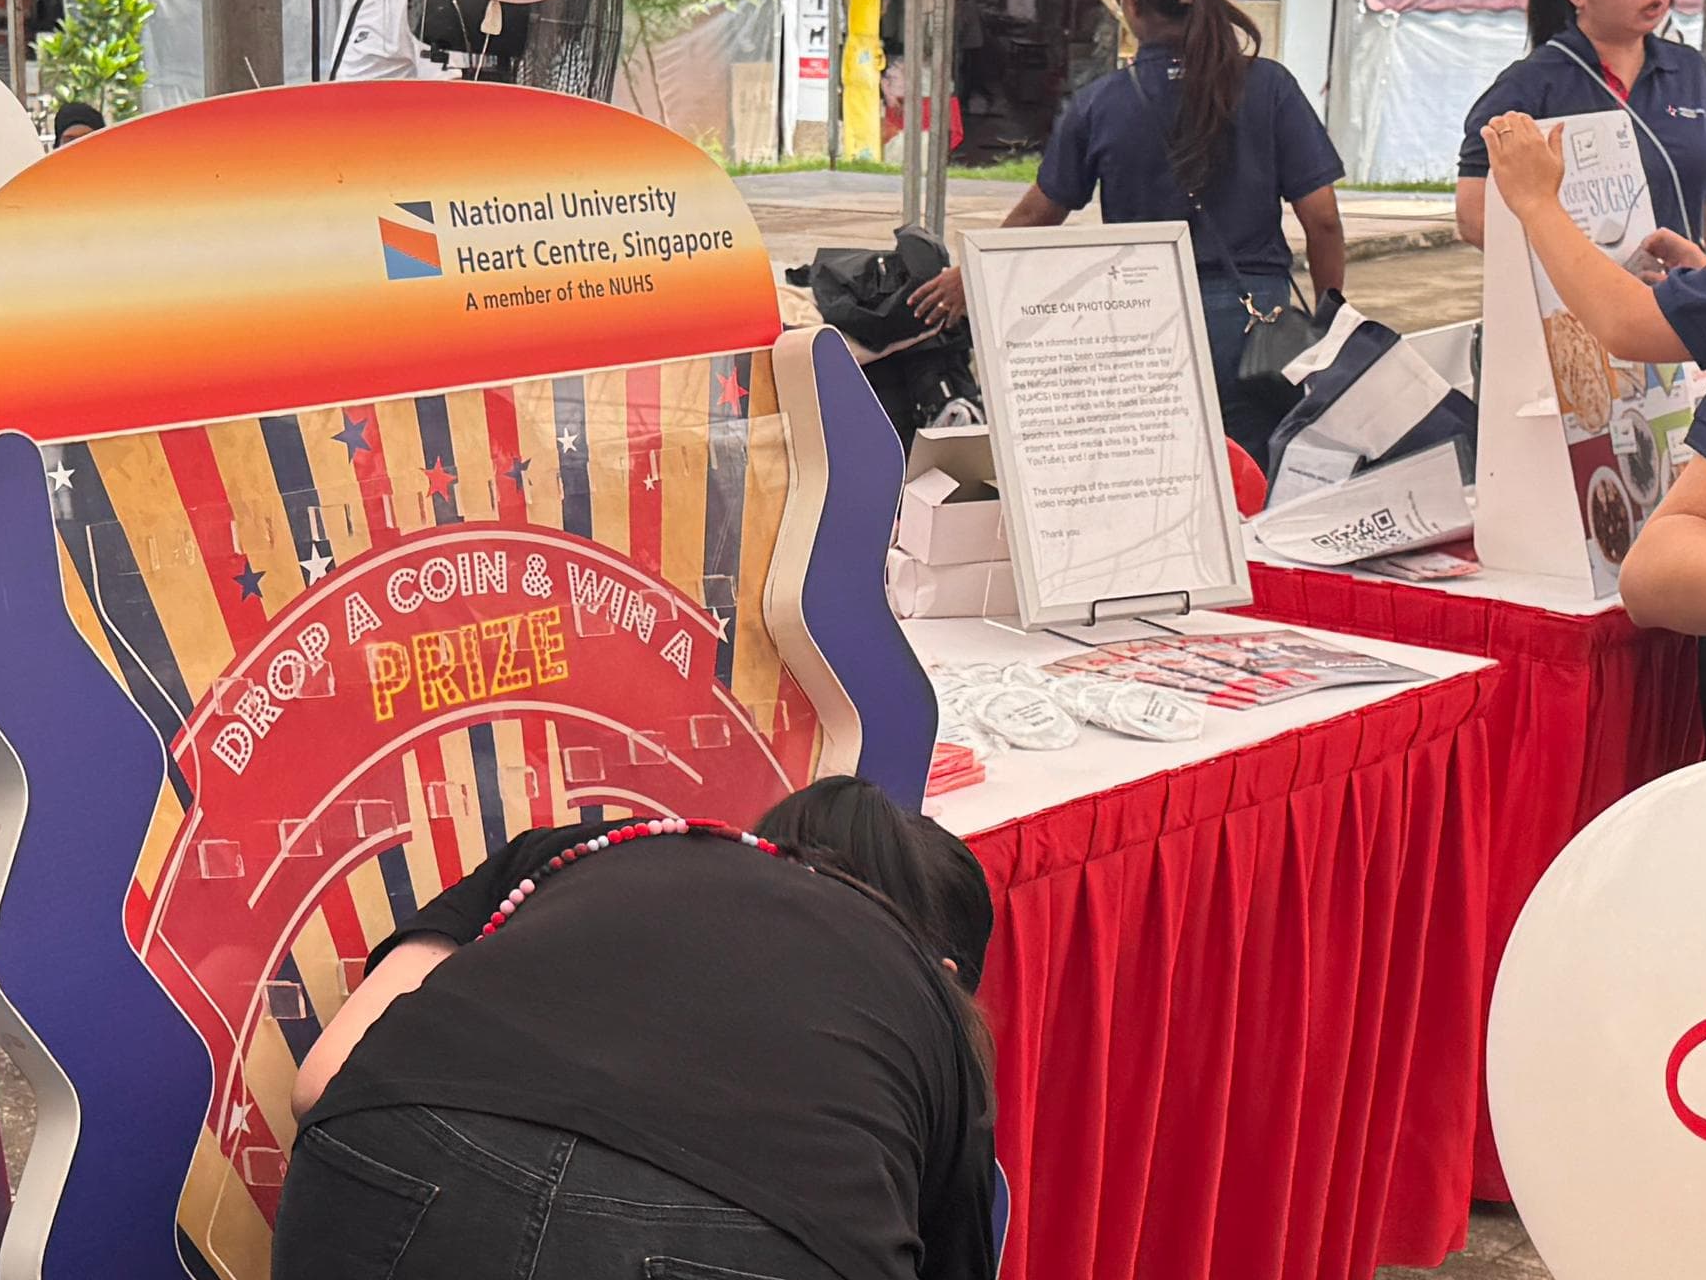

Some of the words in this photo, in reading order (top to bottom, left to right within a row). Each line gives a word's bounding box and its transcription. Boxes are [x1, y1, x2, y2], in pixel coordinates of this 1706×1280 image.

[449, 193, 554, 229] National
[563, 185, 677, 219] University
[1587, 173, 1639, 217] SUGAR
[457, 239, 527, 275] Heart
[533, 233, 618, 267] Centre,
[622, 225, 734, 263] Singapore
[465, 292, 479, 312] A
[483, 286, 552, 311] member
[557, 283, 575, 303] of
[577, 280, 605, 301] the
[609, 275, 654, 296] NUHS
[1021, 302, 1058, 316] NOTICE
[1060, 301, 1075, 313] ON
[1077, 298, 1152, 312] PHOTOGRAPHY
[210, 620, 332, 776] DROP
[344, 592, 382, 646] A
[385, 549, 509, 615] COIN
[521, 552, 554, 600] &
[566, 561, 655, 645] WIN
[659, 629, 693, 680] A
[369, 606, 570, 723] PRIZE
